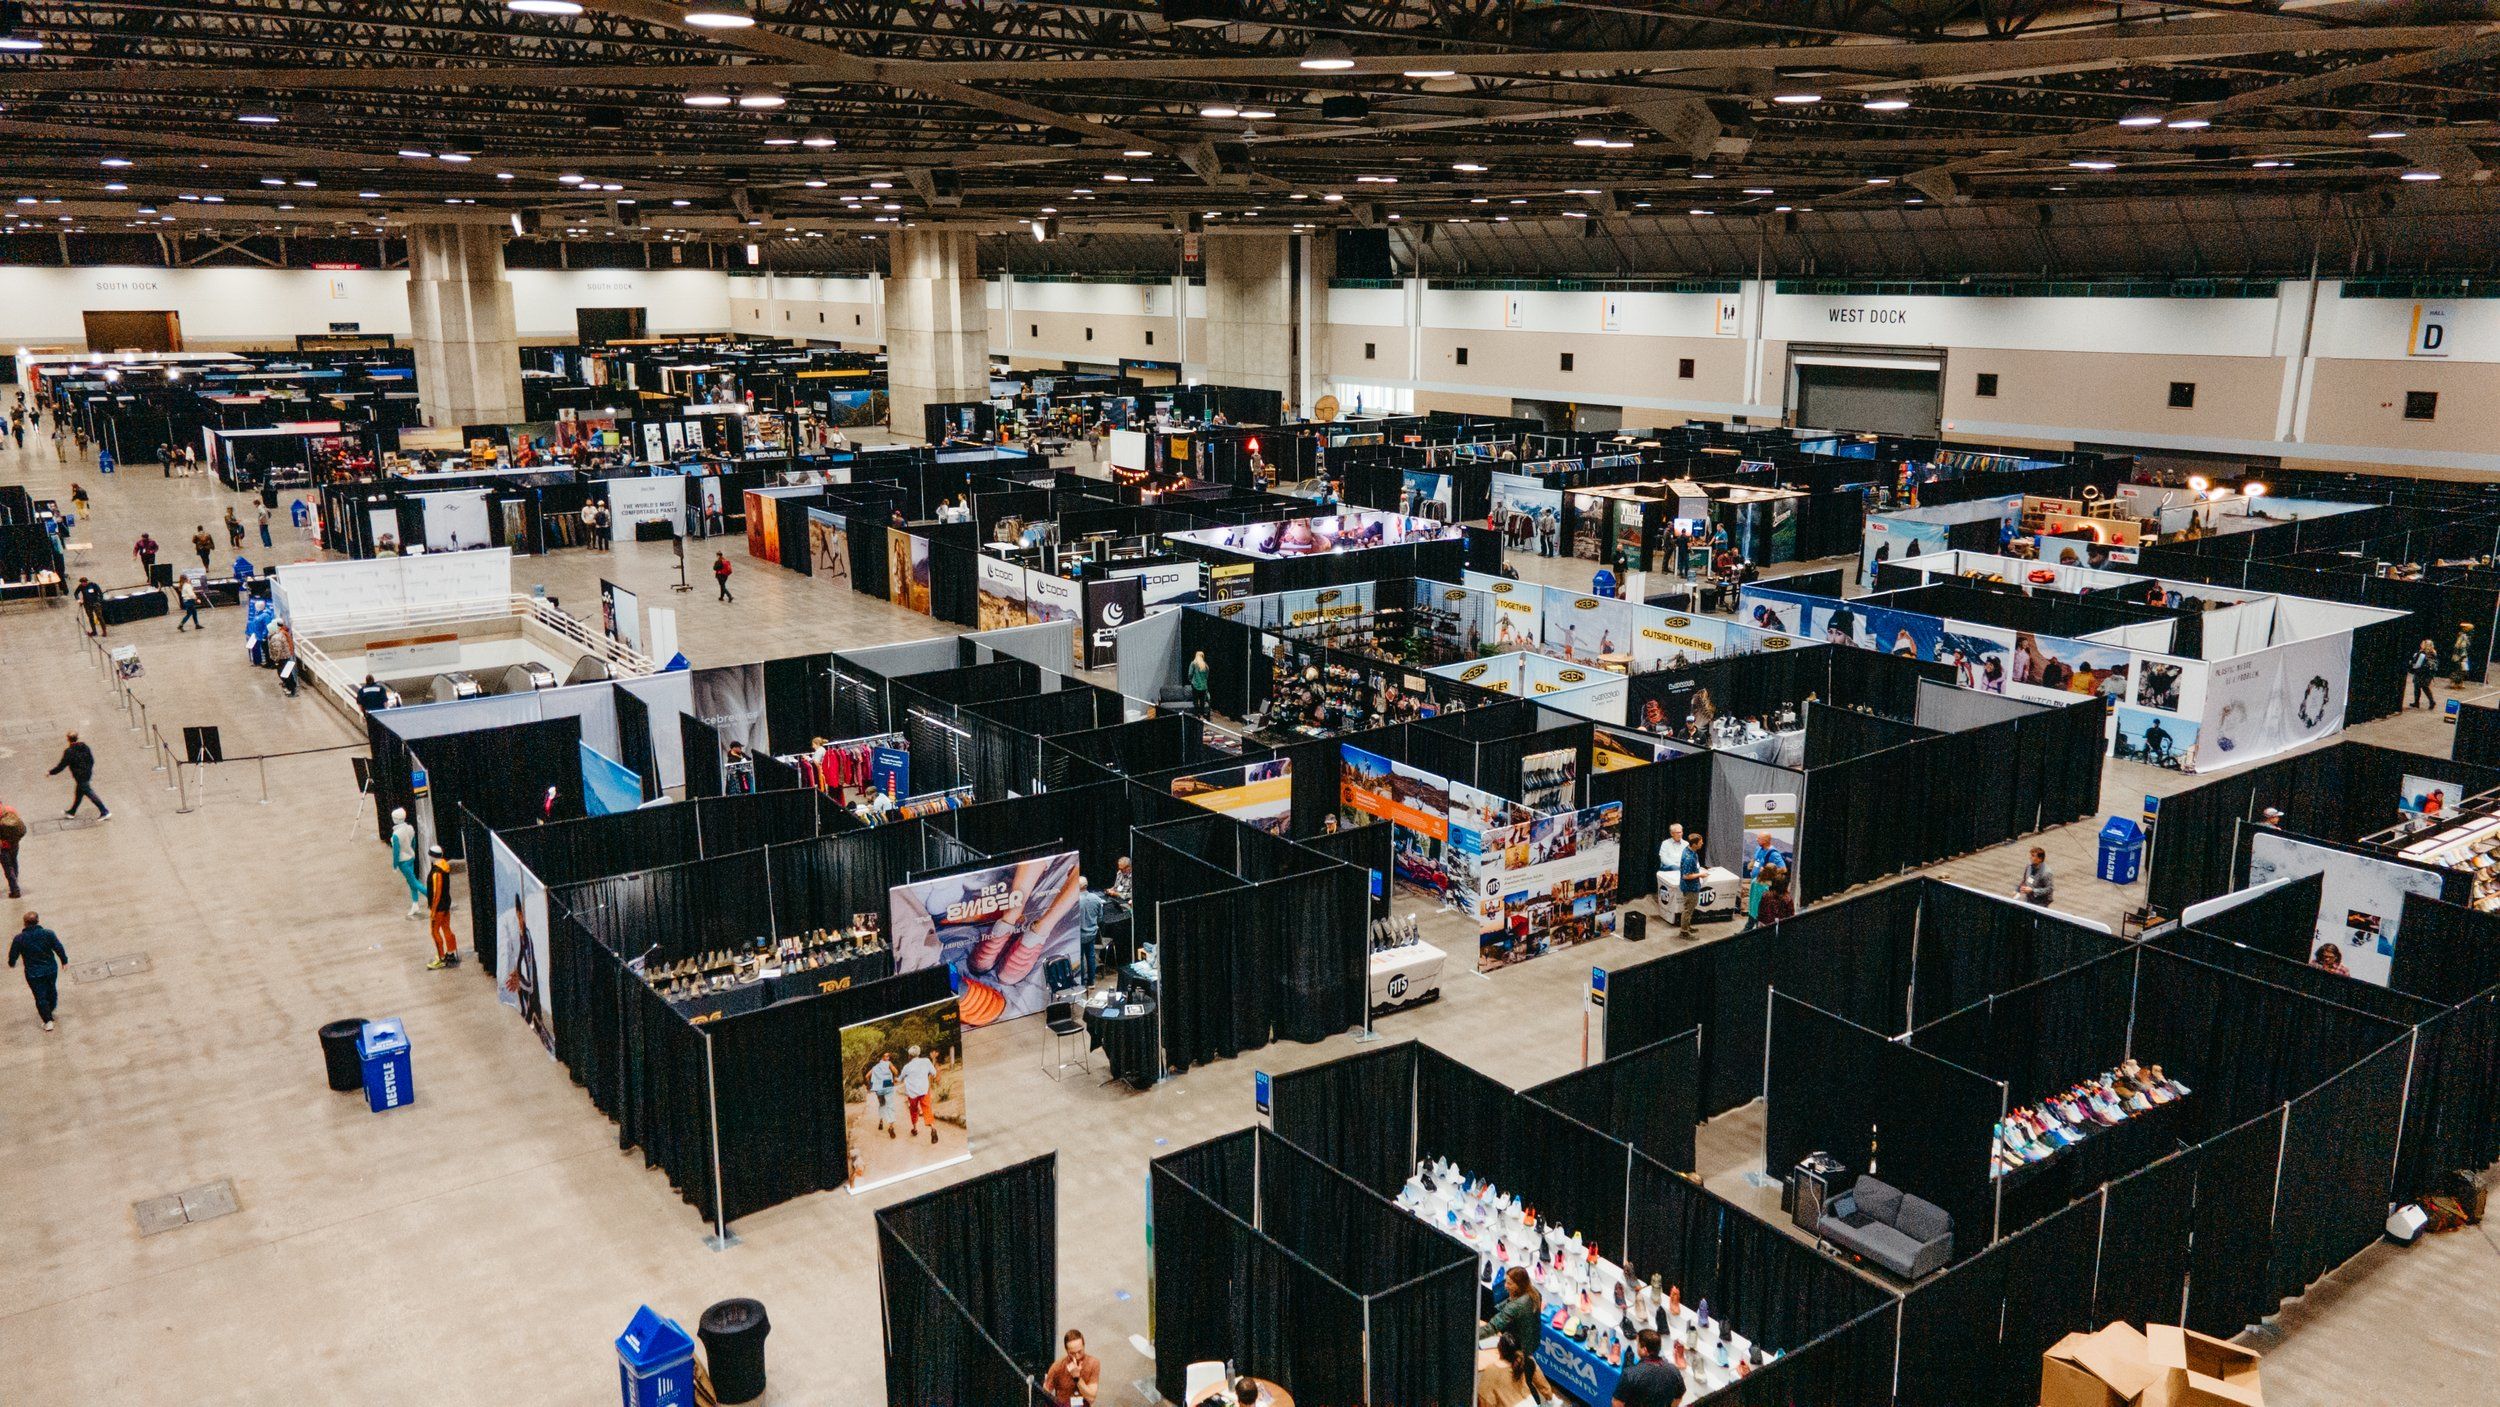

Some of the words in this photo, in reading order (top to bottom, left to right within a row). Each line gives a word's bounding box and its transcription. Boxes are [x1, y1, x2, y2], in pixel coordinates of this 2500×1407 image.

[1829, 309, 1864, 323] WEST
[1870, 310, 1906, 323] DOCK
[2424, 324, 2443, 350] D
[755, 450, 788, 460] STANLEY
[994, 566, 1013, 582] topo
[1046, 583, 1068, 598] topo
[1445, 590, 1466, 600] KEEN
[1493, 583, 1513, 593] KEEN
[1500, 600, 1532, 613] TOGETHER
[1575, 599, 1599, 609] KEEN
[1293, 609, 1323, 621] OUTSIDE
[1325, 605, 1363, 617] TOGETHER
[1665, 617, 1690, 628] KEEN
[1642, 629, 1674, 643] OUTSIDE
[1674, 636, 1713, 651] TOGETHER
[1764, 637, 1791, 648] KEEN
[1461, 664, 1487, 681] KEEN
[1559, 670, 1585, 682] KEEN
[2106, 846, 2118, 881] RECYCLE
[1698, 889, 1715, 904] FITS
[818, 976, 851, 993] Teva
[1389, 976, 1408, 997] FITS
[383, 1061, 398, 1107] RECYCLE
[1540, 1337, 1597, 1387] HOKA
[1535, 1352, 1548, 1365] FLY
[1550, 1361, 1583, 1387] HUMAN
[1583, 1382, 1598, 1397] FLY
